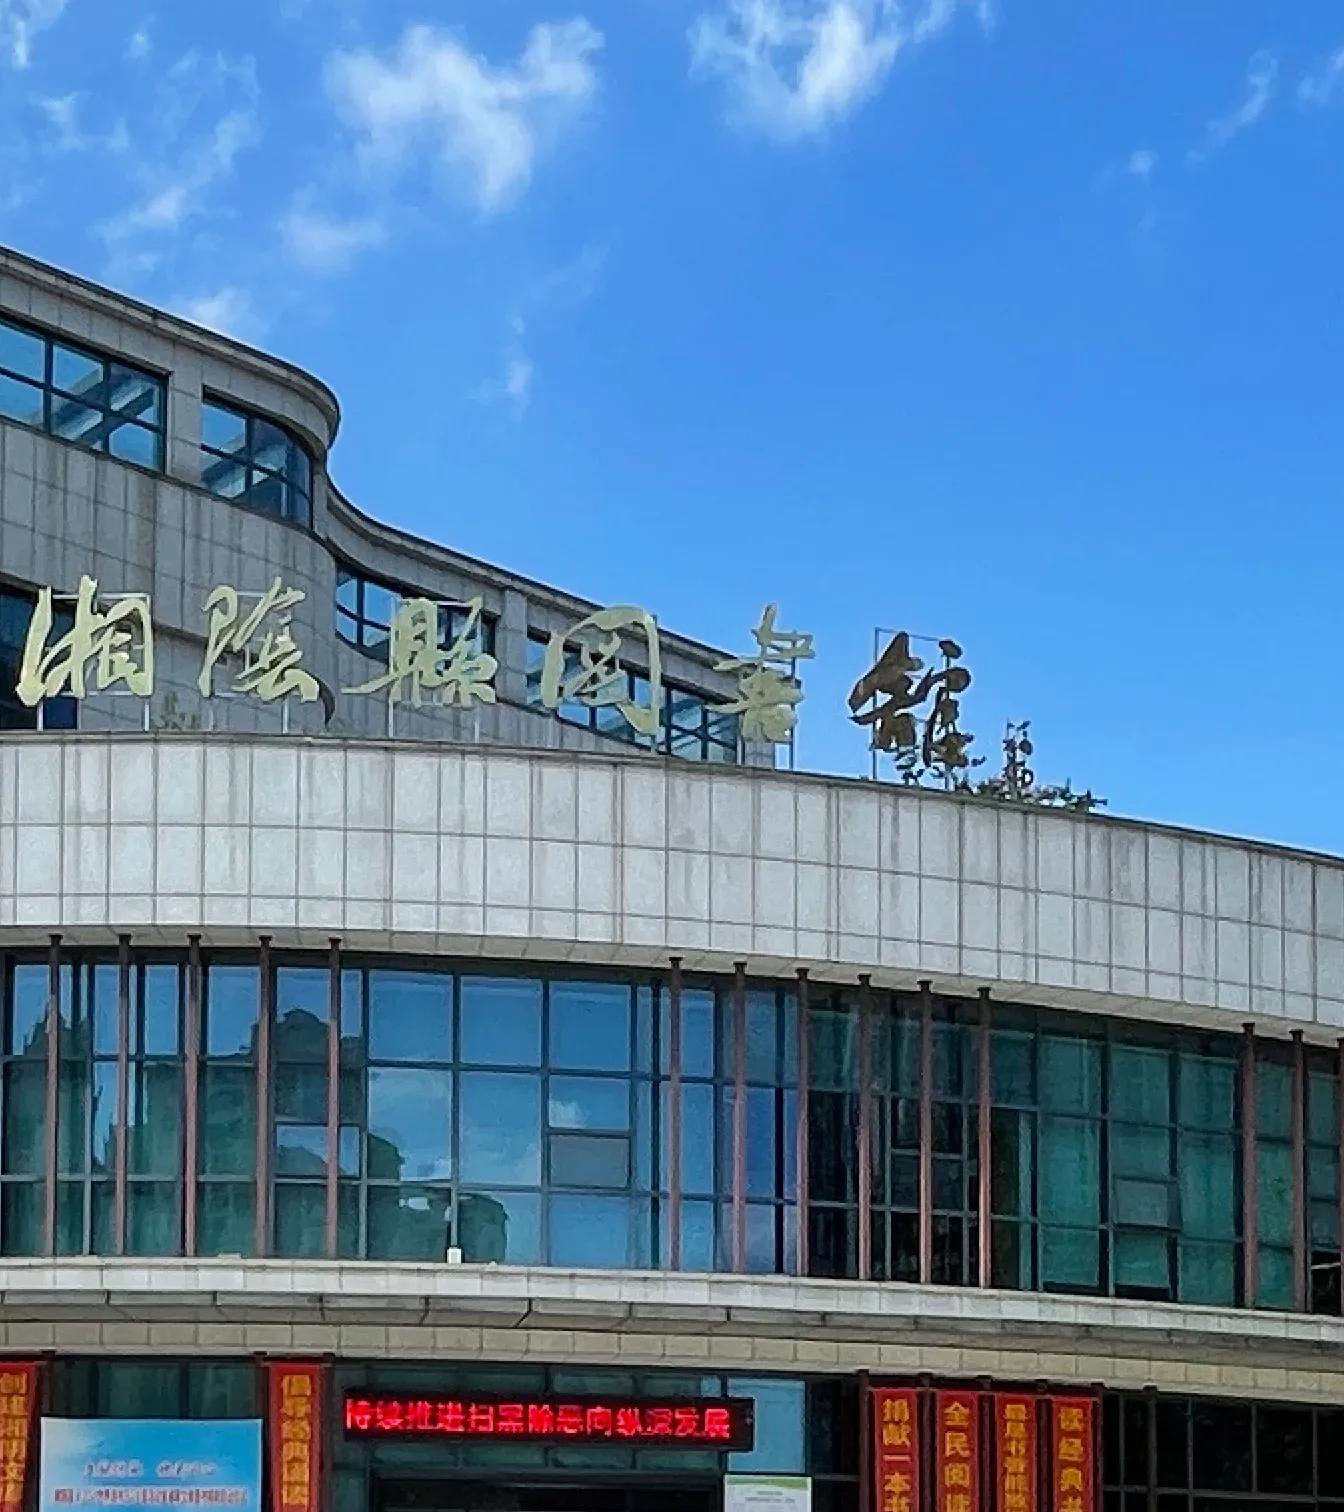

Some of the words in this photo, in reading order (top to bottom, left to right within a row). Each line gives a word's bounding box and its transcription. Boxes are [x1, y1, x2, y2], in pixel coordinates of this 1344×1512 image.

[345, 1397, 731, 1439] 持续推进扫黑除恶向纵深发展
